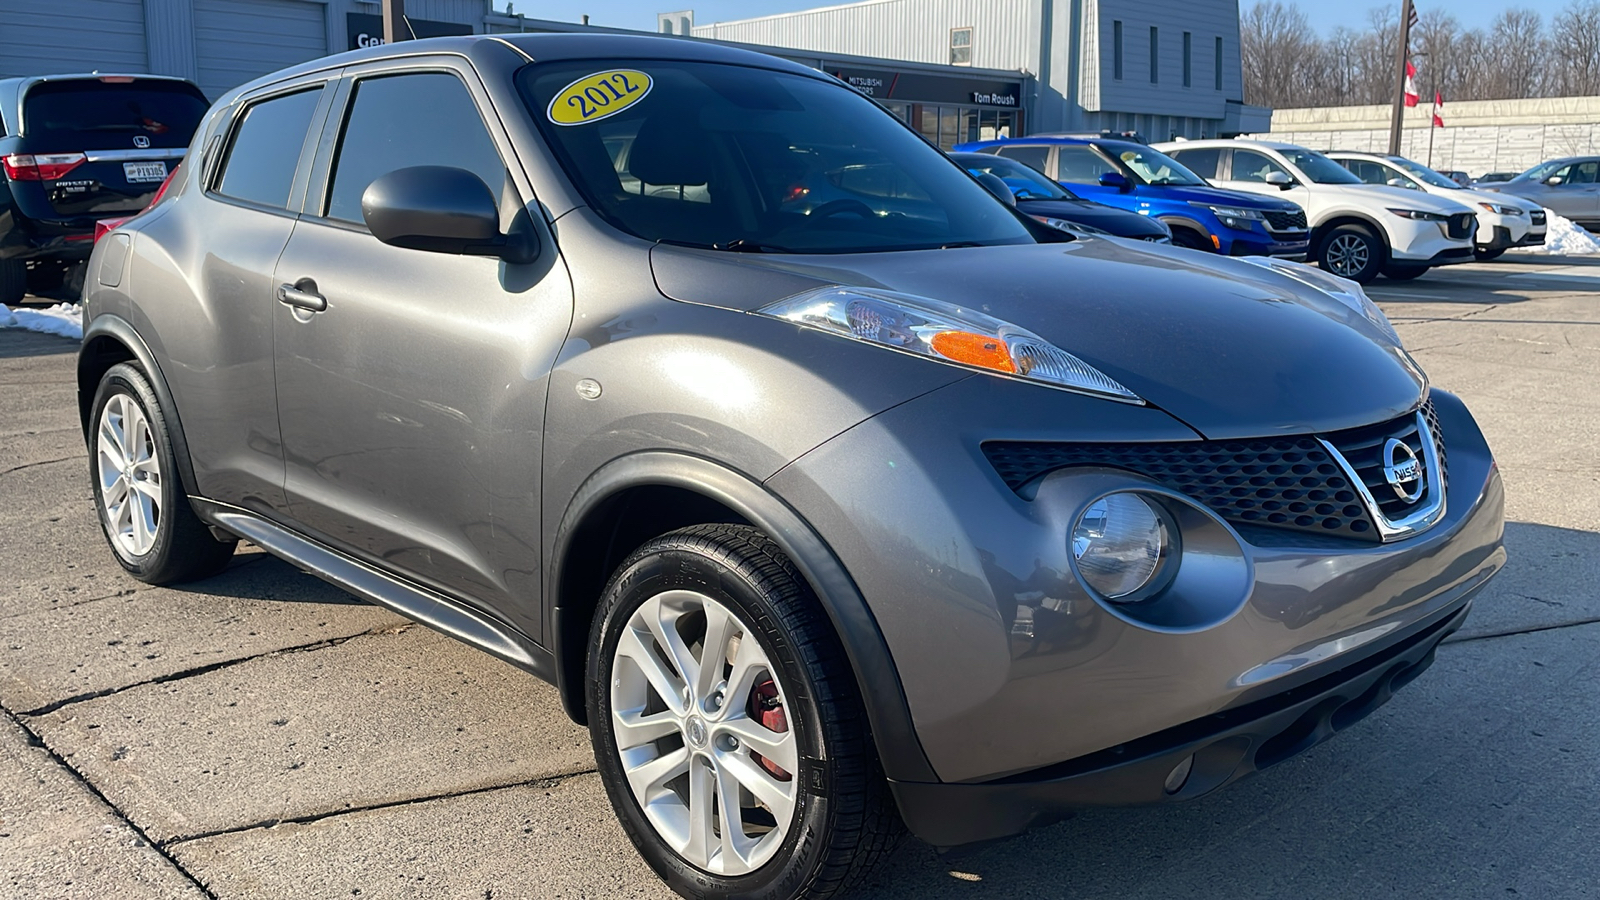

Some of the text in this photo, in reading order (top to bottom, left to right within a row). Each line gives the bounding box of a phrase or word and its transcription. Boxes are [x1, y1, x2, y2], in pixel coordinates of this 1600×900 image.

[848, 76, 883, 87] MITSUBISHI
[567, 73, 640, 118] 2012
[854, 86, 875, 96] TORS
[973, 91, 1015, 106] Tom Roush
